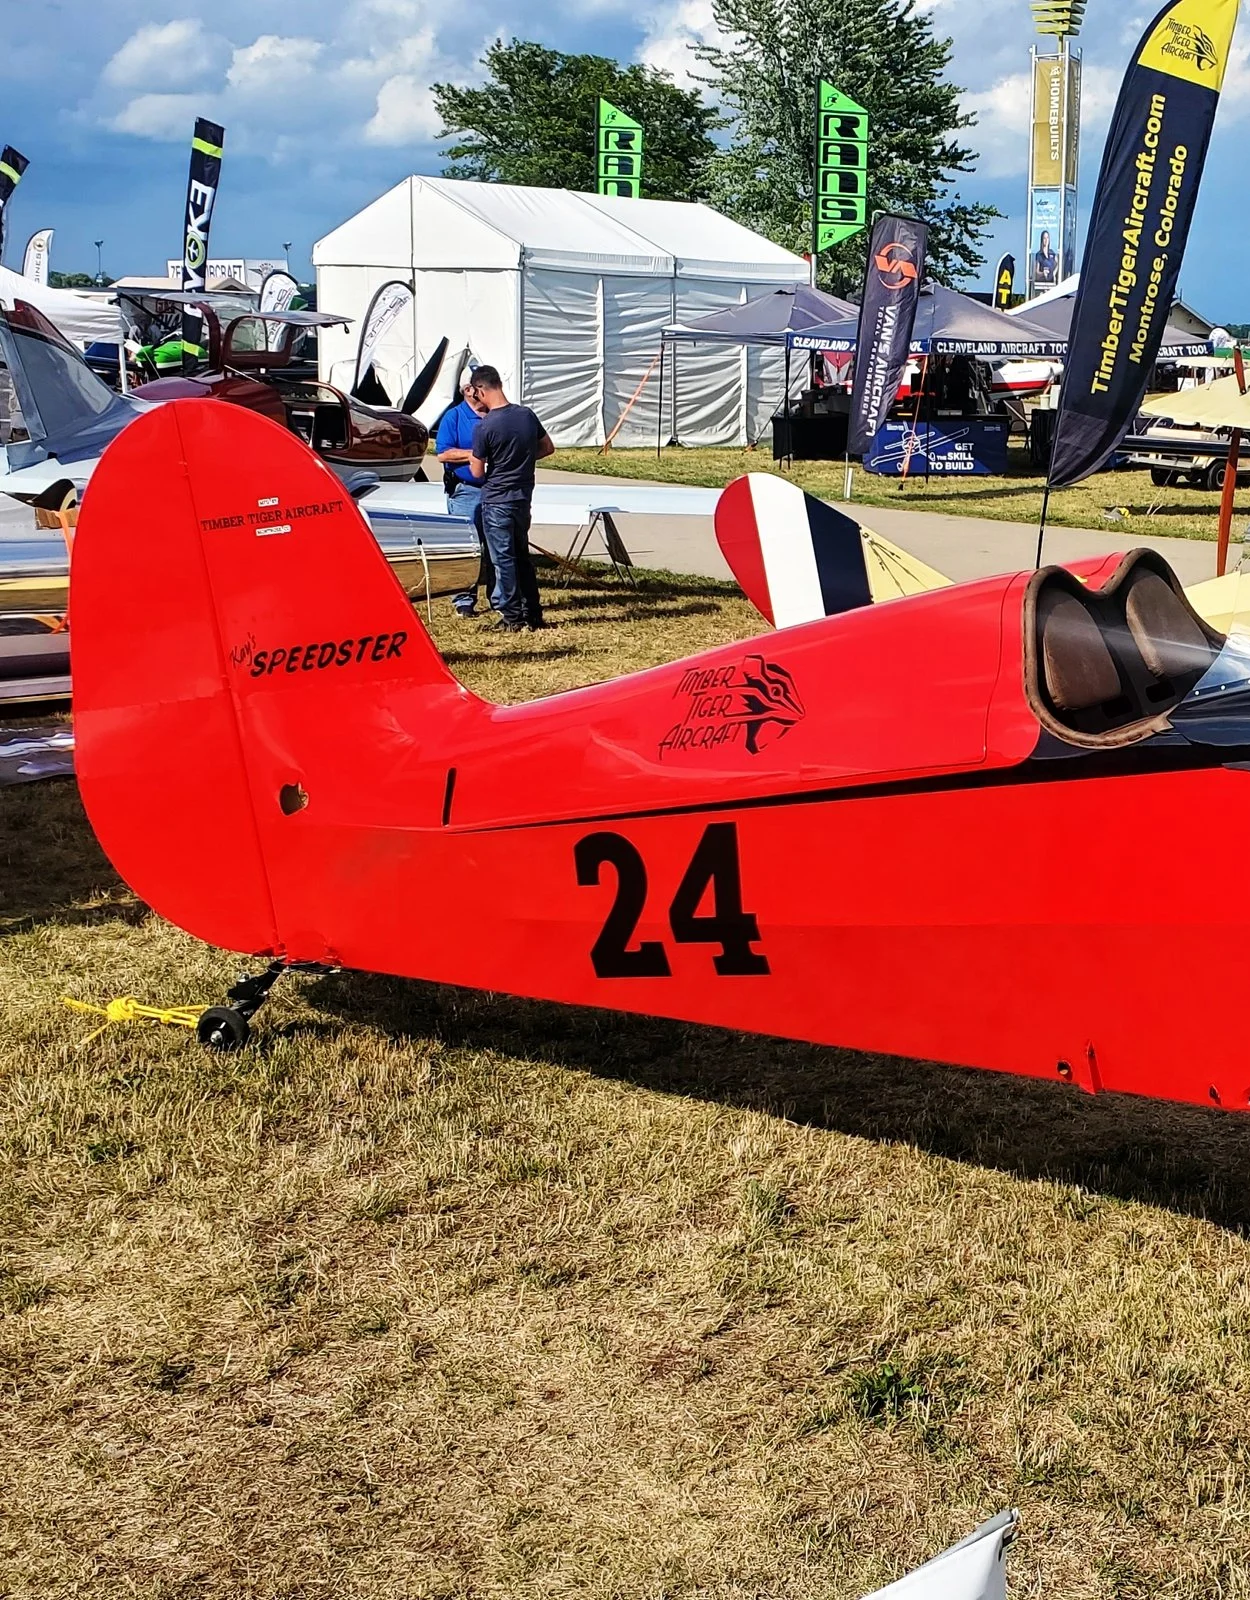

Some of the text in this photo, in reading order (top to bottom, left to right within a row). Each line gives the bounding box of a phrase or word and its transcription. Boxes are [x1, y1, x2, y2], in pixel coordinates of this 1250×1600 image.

[1165, 17, 1192, 37] TIMBER
[1171, 31, 1191, 48] TIGER
[1161, 42, 1196, 62] AIRCRAFT
[1049, 78, 1061, 161] HOMEBUILTS
[603, 129, 636, 198] RAN
[821, 114, 861, 221] RANS
[1091, 93, 1167, 395] TimberTigerAircraft.com
[1128, 144, 1189, 364] Montrose, Colorado
[793, 337, 850, 351] CLEAVELAND
[936, 342, 1068, 354] CLEAVELAND AIRCRAFT TOO
[1157, 345, 1186, 357] CRAFT
[947, 452, 974, 461] SKILL
[954, 442, 974, 451] GET
[929, 461, 974, 470] TO BUILD
[201, 500, 344, 531] TIMBER TIGER AIRCRAFT
[250, 631, 408, 678] SPEEDSTER
[672, 666, 737, 700] TIMBER
[683, 691, 733, 727] TIGER
[658, 721, 746, 761] AIRCRAFT
[573, 821, 772, 979] 24
